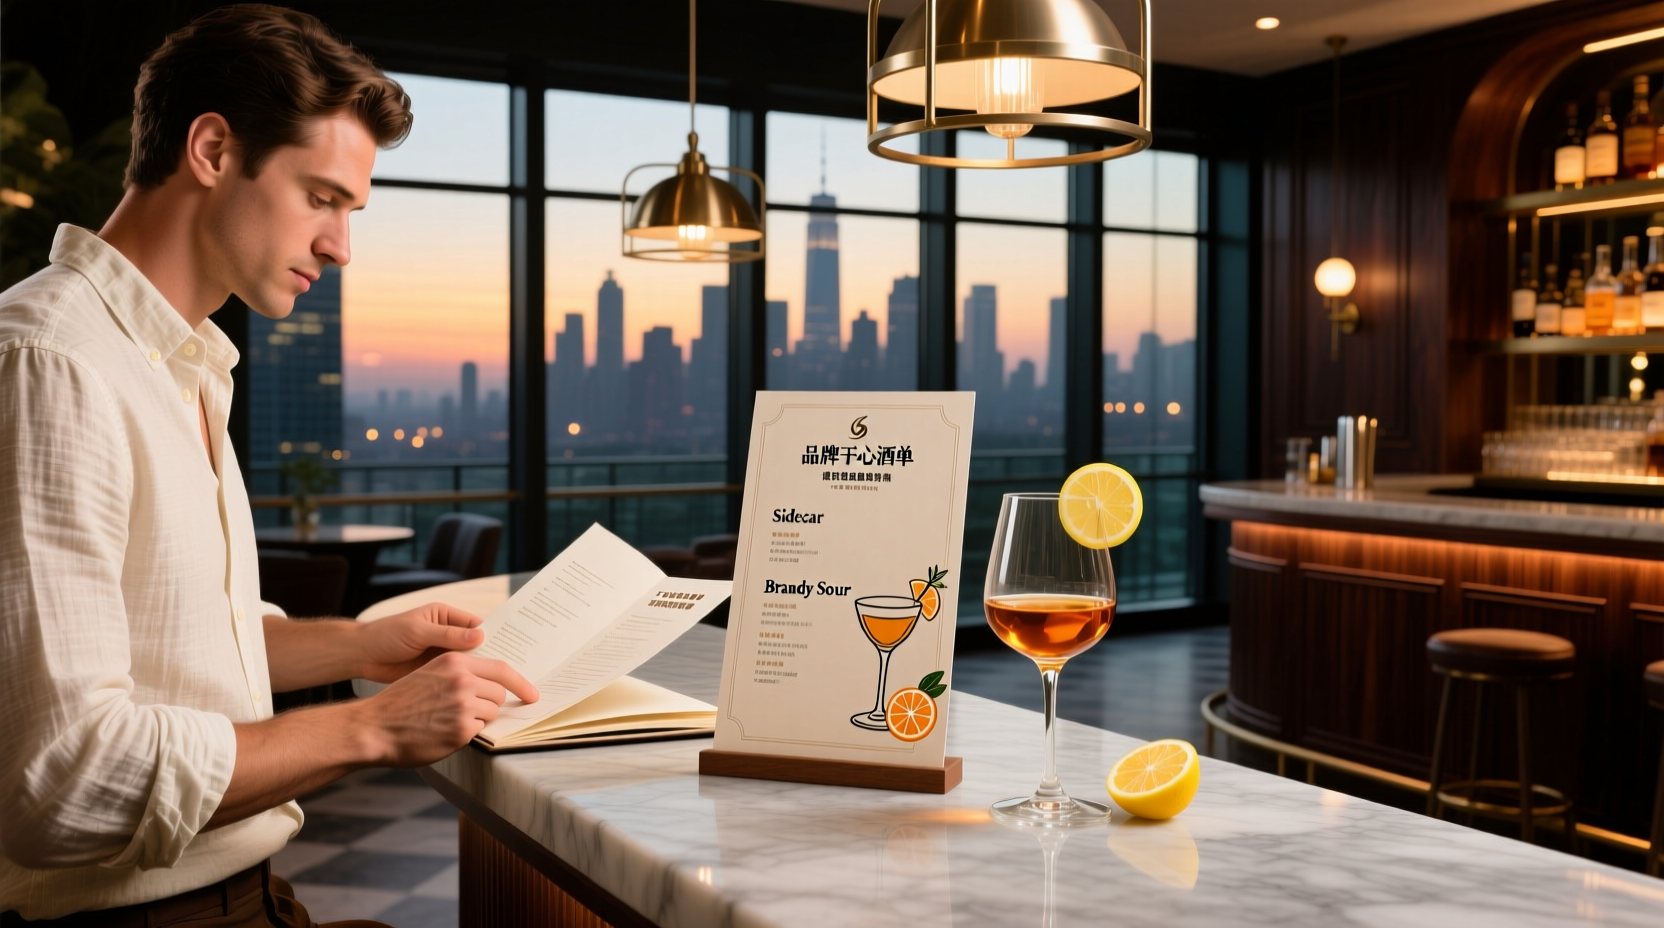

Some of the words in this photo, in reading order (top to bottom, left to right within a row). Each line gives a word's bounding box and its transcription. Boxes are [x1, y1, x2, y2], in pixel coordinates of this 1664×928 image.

[772, 508, 825, 524] Sidecar
[763, 579, 814, 599] Brandy
[816, 580, 852, 597] Sour
